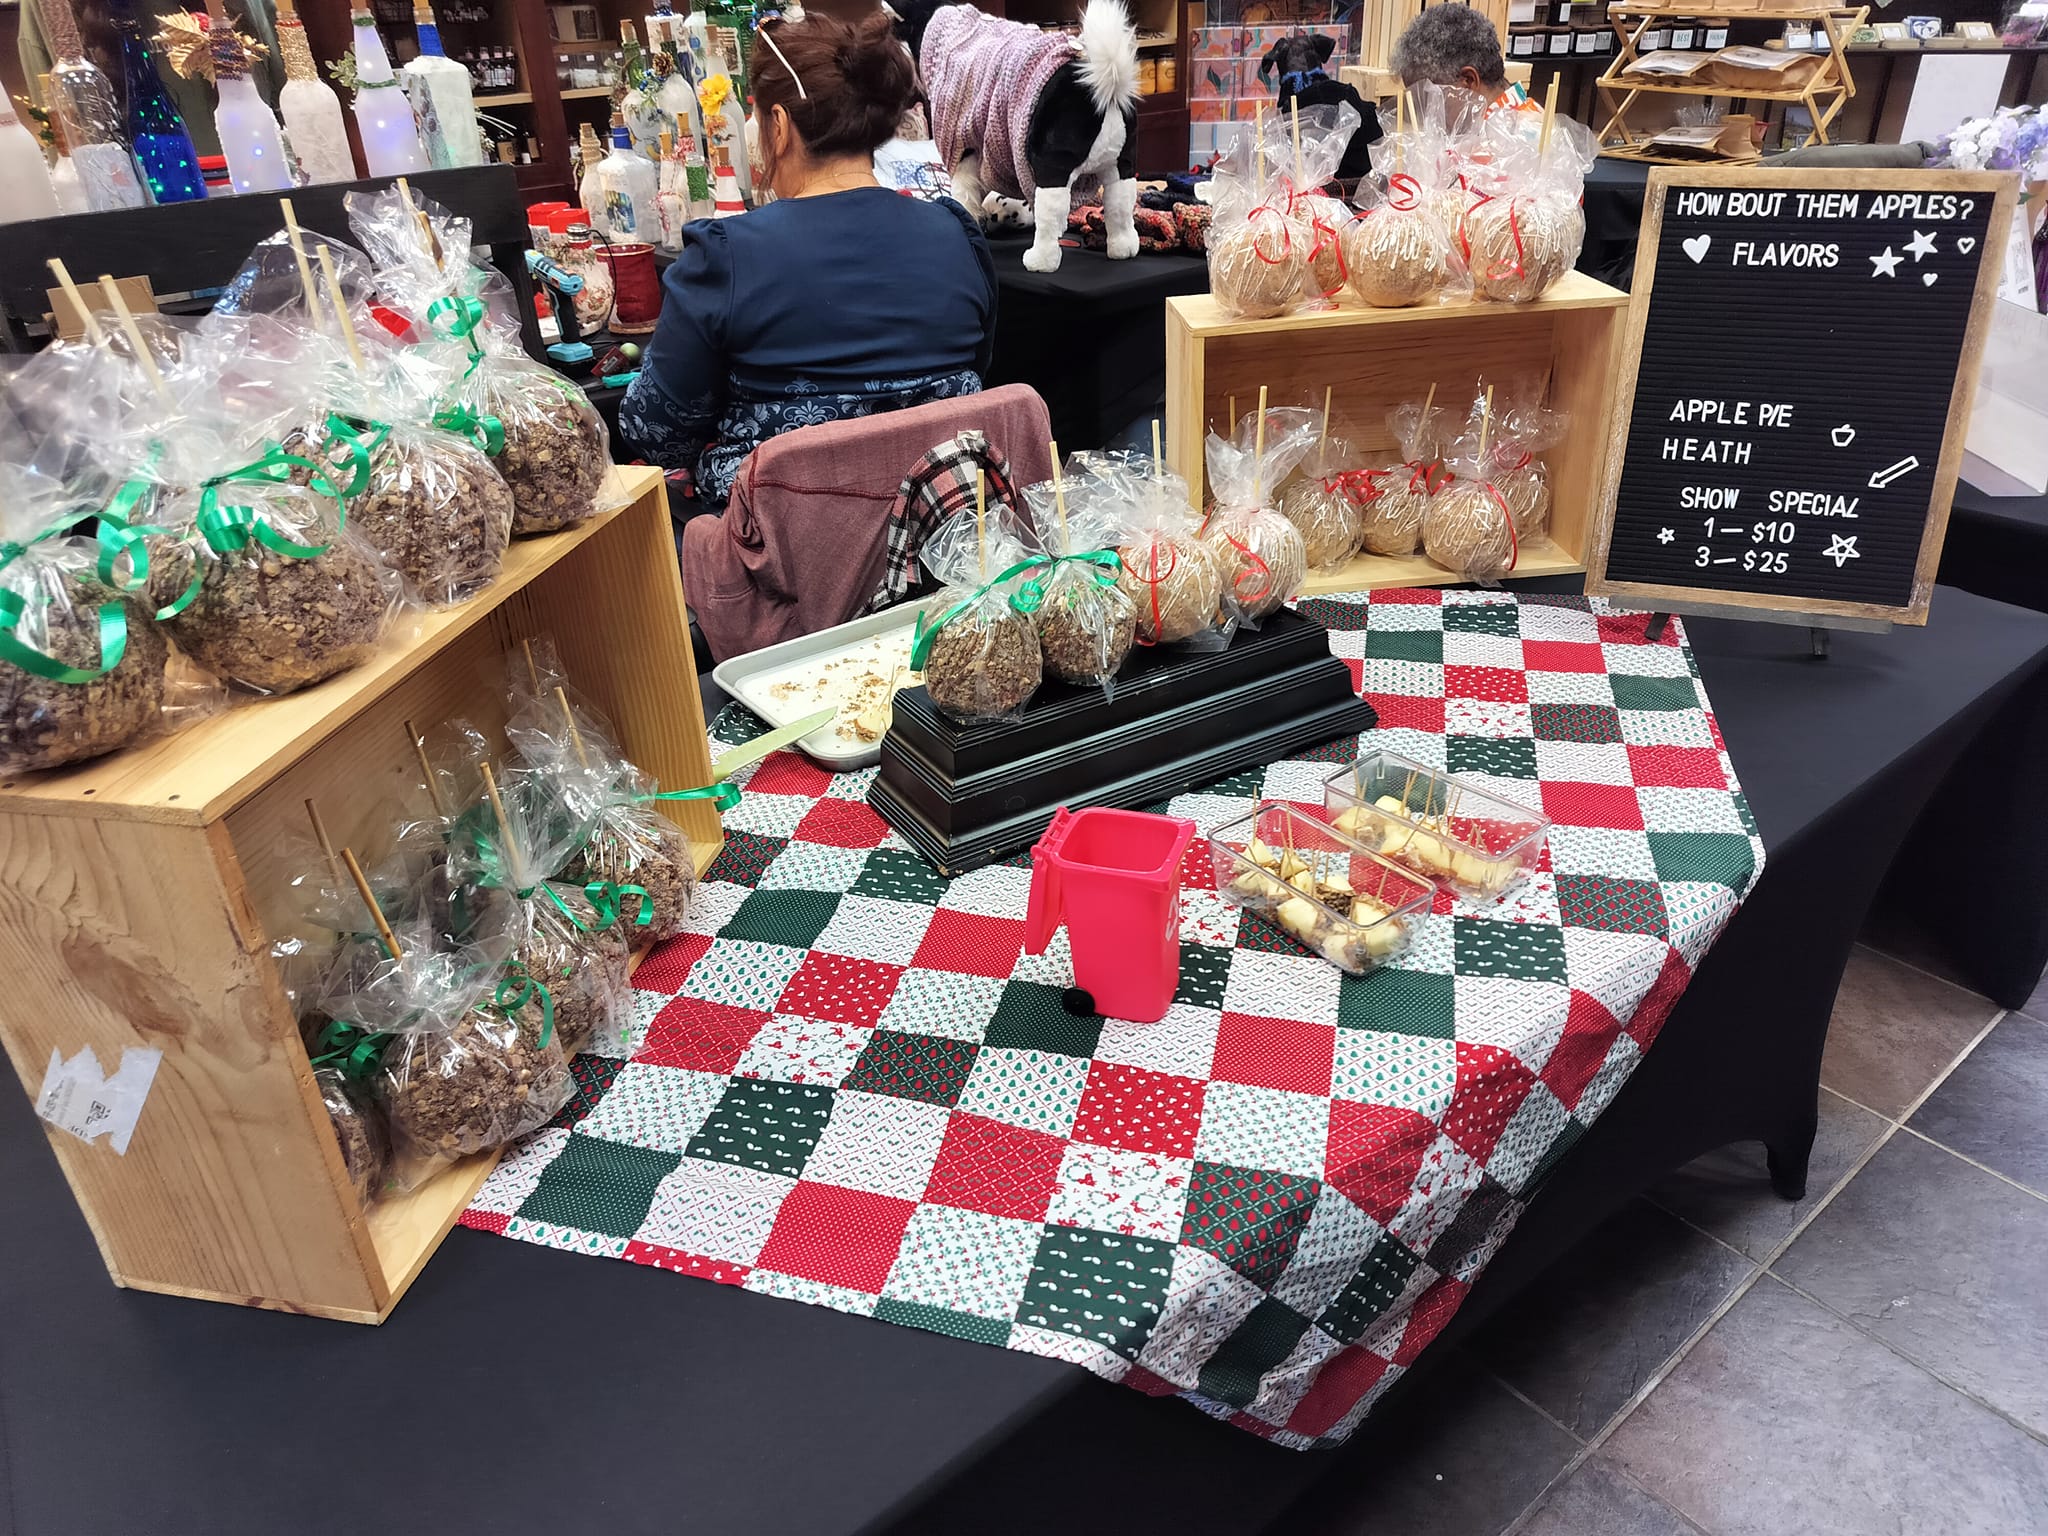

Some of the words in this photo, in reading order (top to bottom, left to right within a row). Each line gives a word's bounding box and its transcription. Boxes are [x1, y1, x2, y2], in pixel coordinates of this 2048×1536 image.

[1677, 191, 1724, 217] HOW
[1726, 191, 1787, 218] BOUT
[1796, 193, 1859, 219] THEM
[1866, 194, 1975, 220] APPLES?
[1732, 242, 1840, 268] FLAVORS
[1669, 399, 1751, 425] APPLE
[1758, 403, 1794, 428] PIE
[1662, 437, 1752, 465] HEATH
[1679, 486, 1740, 510] SHOW
[1768, 490, 1860, 519] SPECIAL
